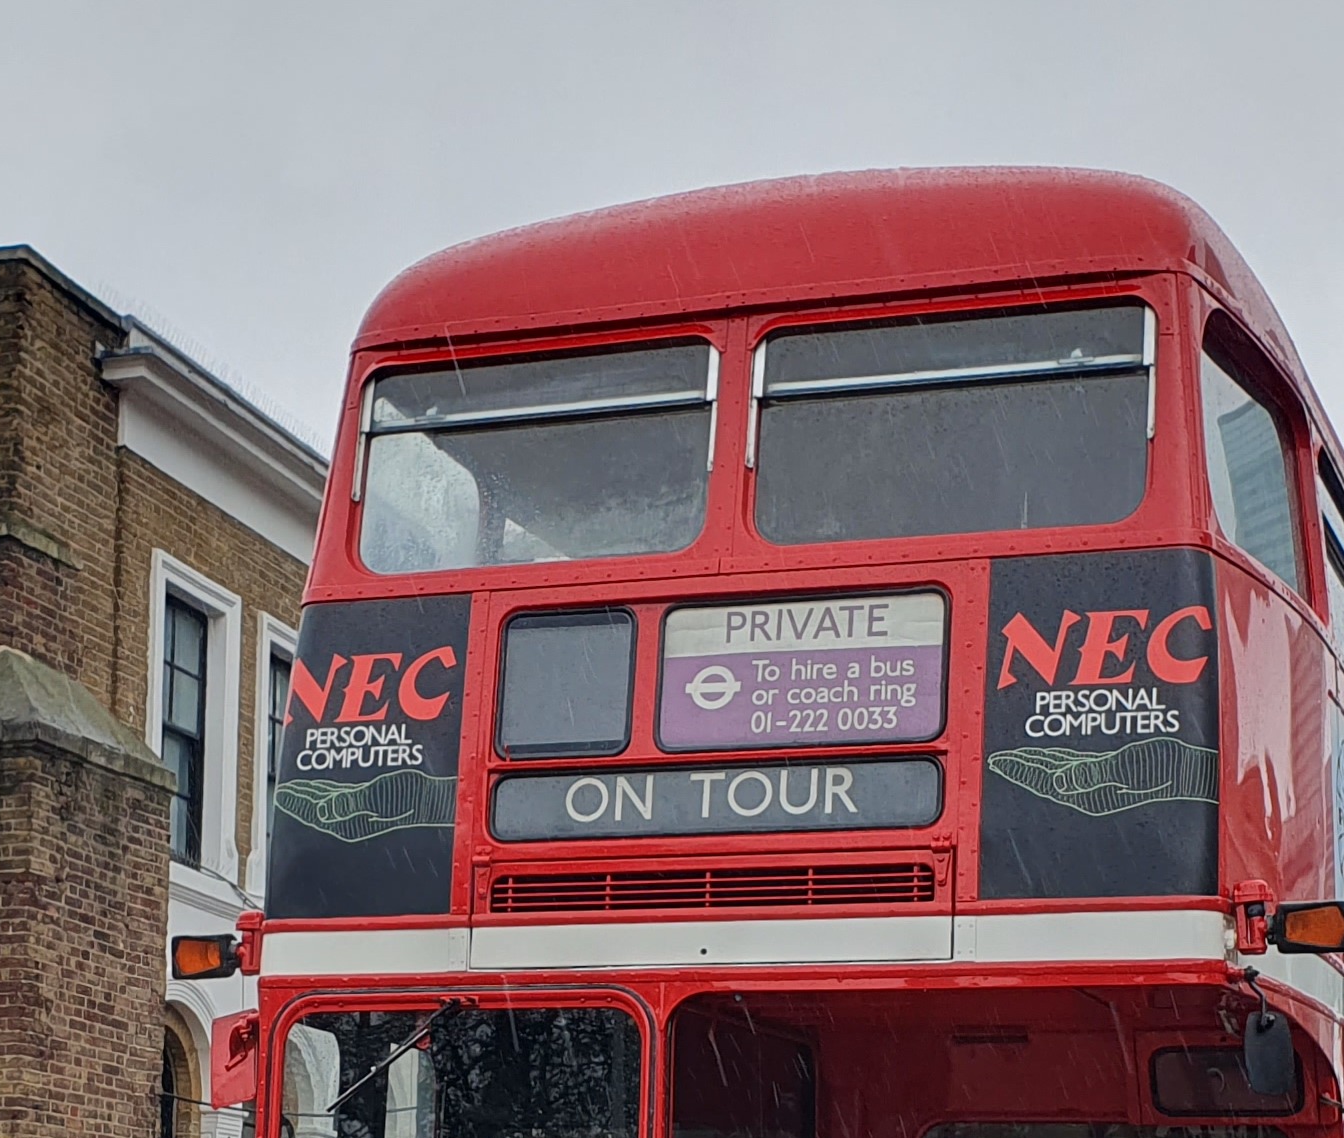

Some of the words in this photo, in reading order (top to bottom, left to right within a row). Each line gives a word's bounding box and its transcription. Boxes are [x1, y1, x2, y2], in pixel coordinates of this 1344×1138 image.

[725, 604, 889, 643] PRIVATE
[997, 605, 1212, 690] NEC
[752, 660, 780, 682] To
[791, 658, 837, 680] hire
[847, 662, 860, 679] a
[870, 656, 915, 677] bus
[284, 646, 457, 727] NEC
[752, 687, 779, 705] or
[787, 681, 858, 704] coach
[870, 681, 917, 707] ring
[1035, 687, 1166, 714] PERSONAL
[750, 709, 828, 733] 01-222
[838, 706, 898, 731] 0033
[1025, 710, 1179, 737] COMPUTERS
[306, 723, 412, 749] PERSONAL
[296, 744, 423, 771] COMPUTERS
[565, 774, 654, 823] ON
[690, 767, 858, 819] TOUR
